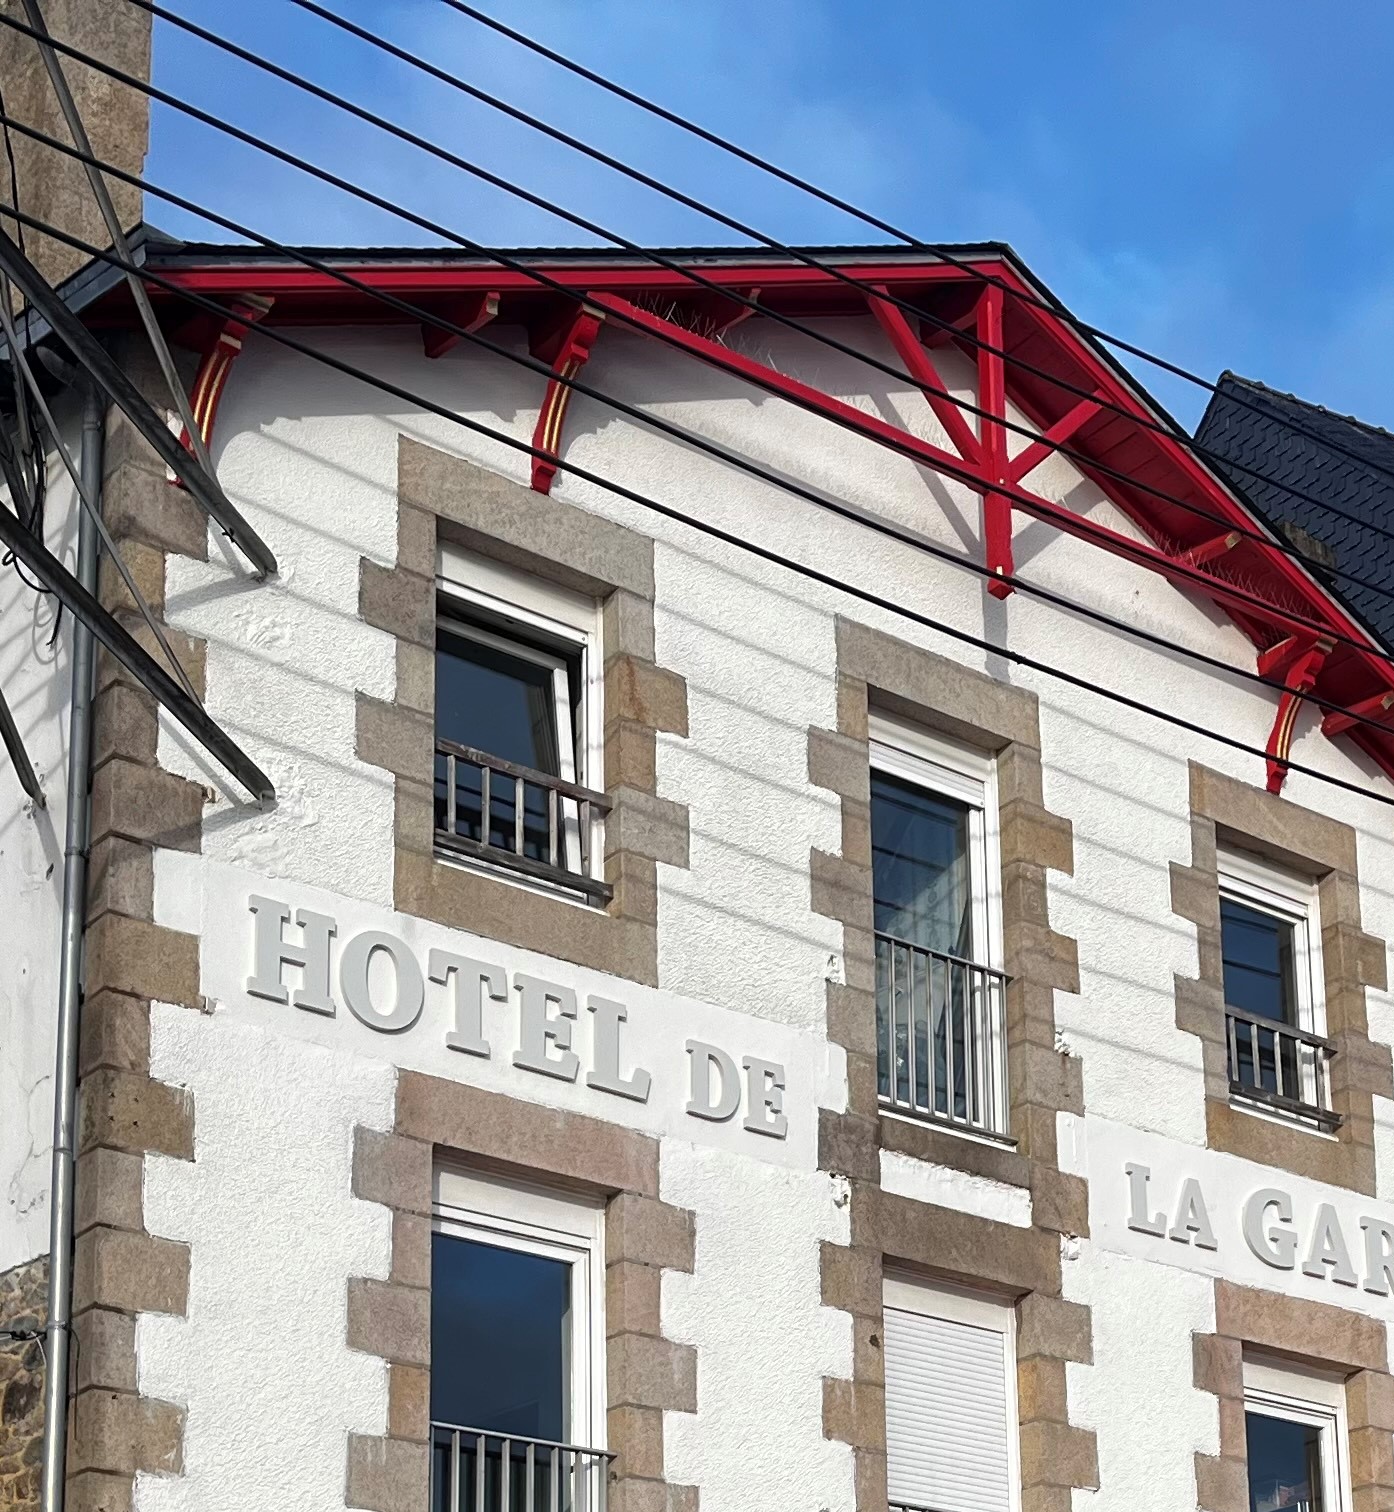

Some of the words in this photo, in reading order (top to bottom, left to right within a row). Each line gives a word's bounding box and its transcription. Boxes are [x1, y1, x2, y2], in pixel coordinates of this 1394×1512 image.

[247, 894, 651, 1103] HOTEL
[686, 1039, 788, 1140] DE
[1125, 1162, 1218, 1252] LA
